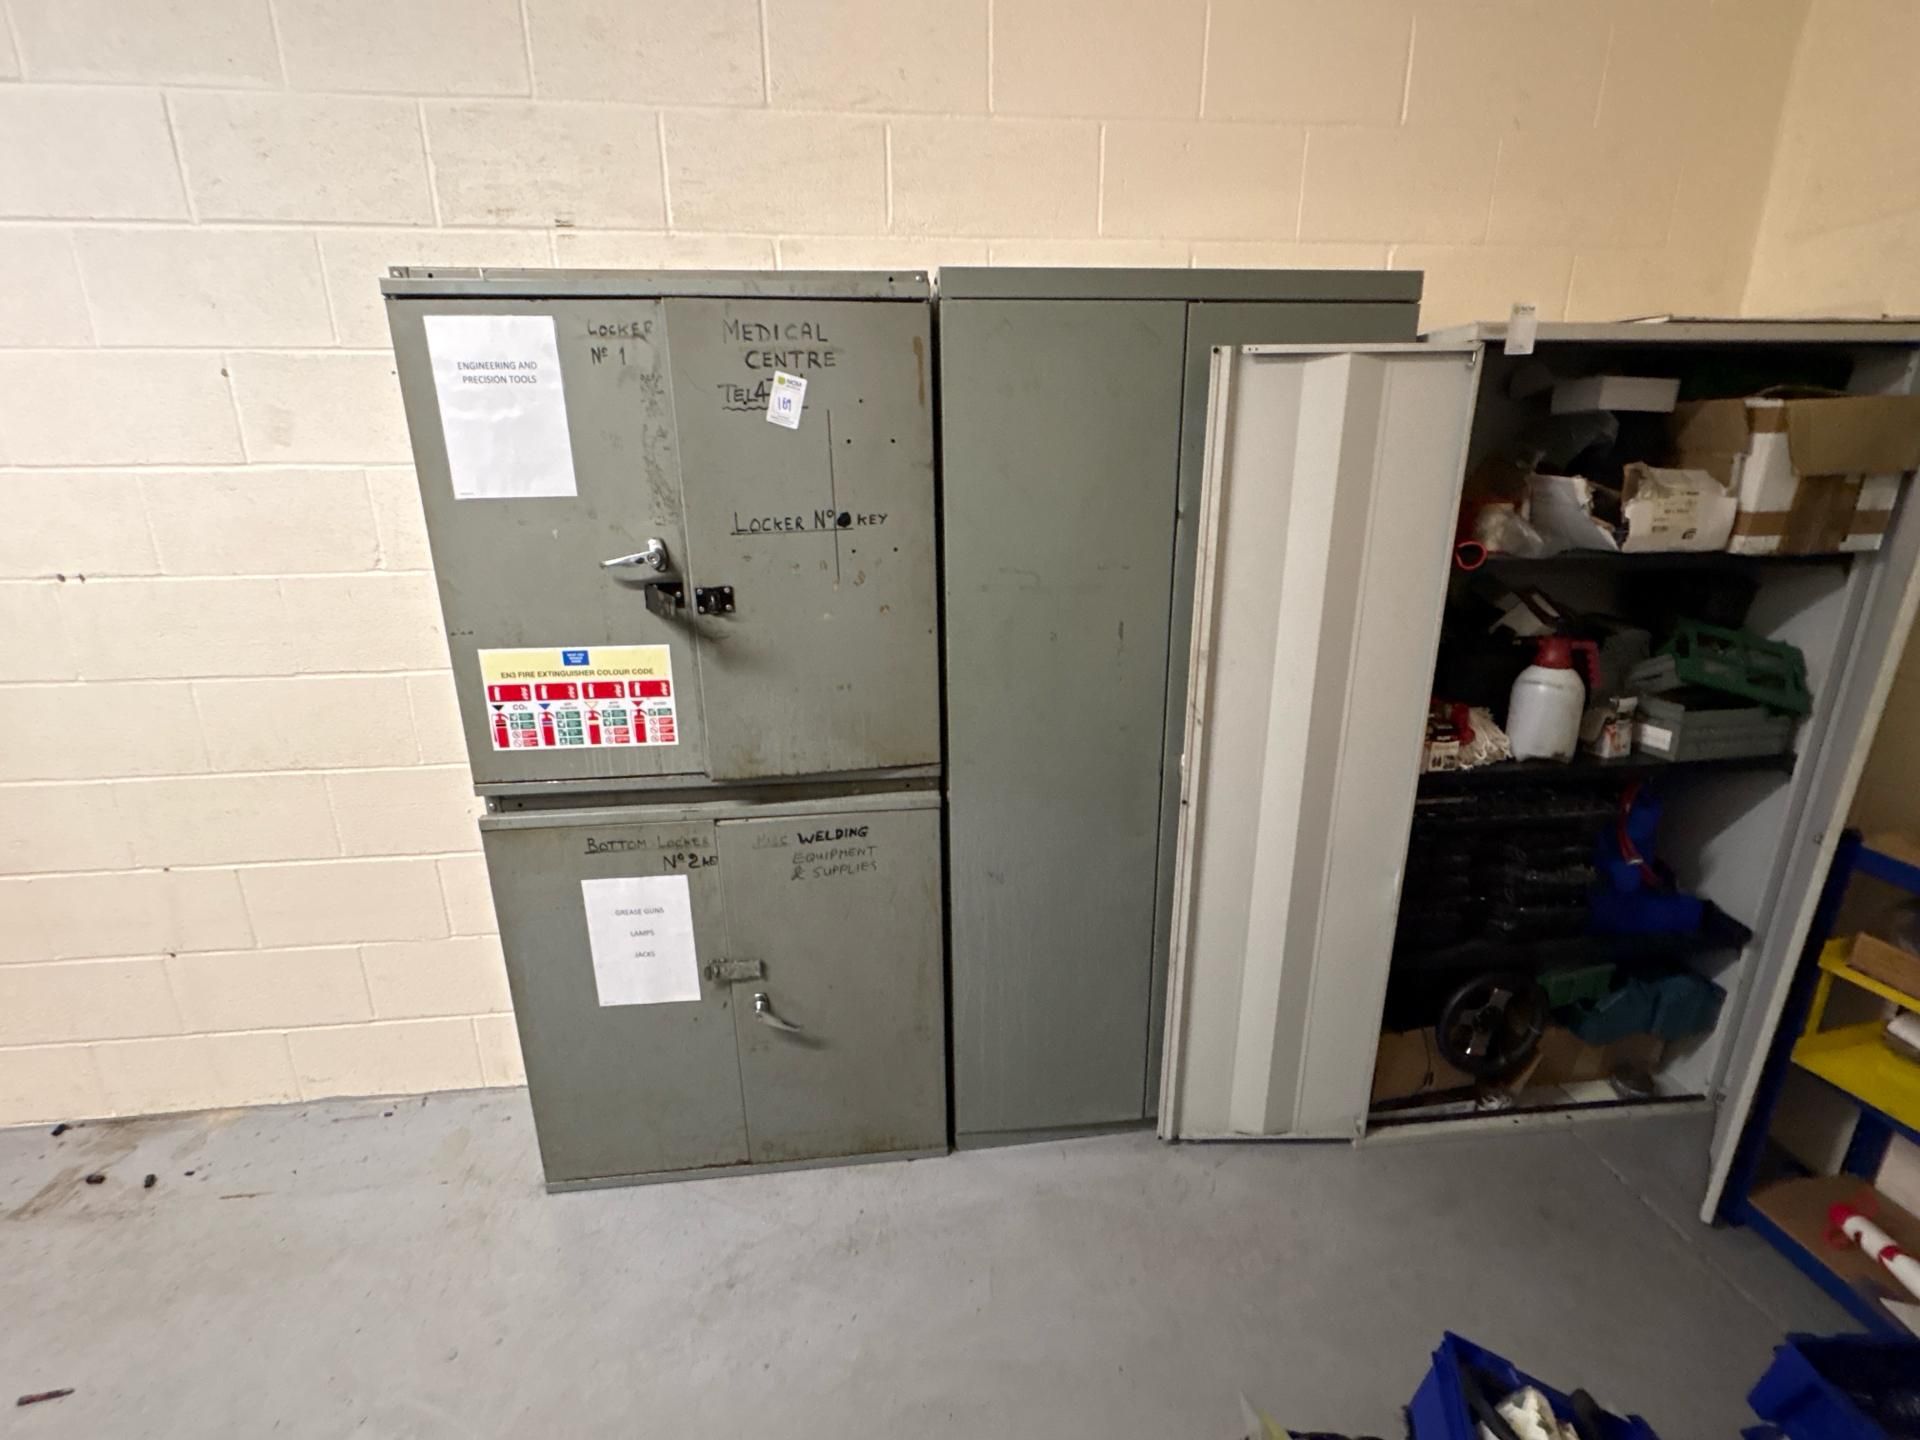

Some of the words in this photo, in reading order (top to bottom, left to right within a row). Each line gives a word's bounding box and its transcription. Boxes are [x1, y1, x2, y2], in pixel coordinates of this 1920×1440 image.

[586, 319, 653, 338] LOCKER
[722, 319, 828, 343] MEDICAL
[619, 346, 626, 365] 1
[744, 350, 837, 370] CENTRE
[457, 361, 516, 371] ENGINEERING
[518, 361, 537, 371] AND
[462, 375, 507, 384] PRECISION
[509, 375, 537, 384] TOOLS
[734, 511, 805, 533] LOCKER
[857, 513, 888, 526] KEY
[500, 671, 516, 679] EN3
[537, 669, 595, 678] EXTINGUISHER
[596, 668, 630, 677] COLOUR
[586, 837, 647, 852] BOTTOM
[797, 825, 869, 845] WELDING
[792, 845, 877, 865] EQUIPMENT
[791, 865, 805, 881] &
[813, 861, 878, 878] SUPPLIES
[614, 908, 641, 917] GREASE
[642, 906, 665, 914] GUNS
[629, 929, 656, 937] LAMPS
